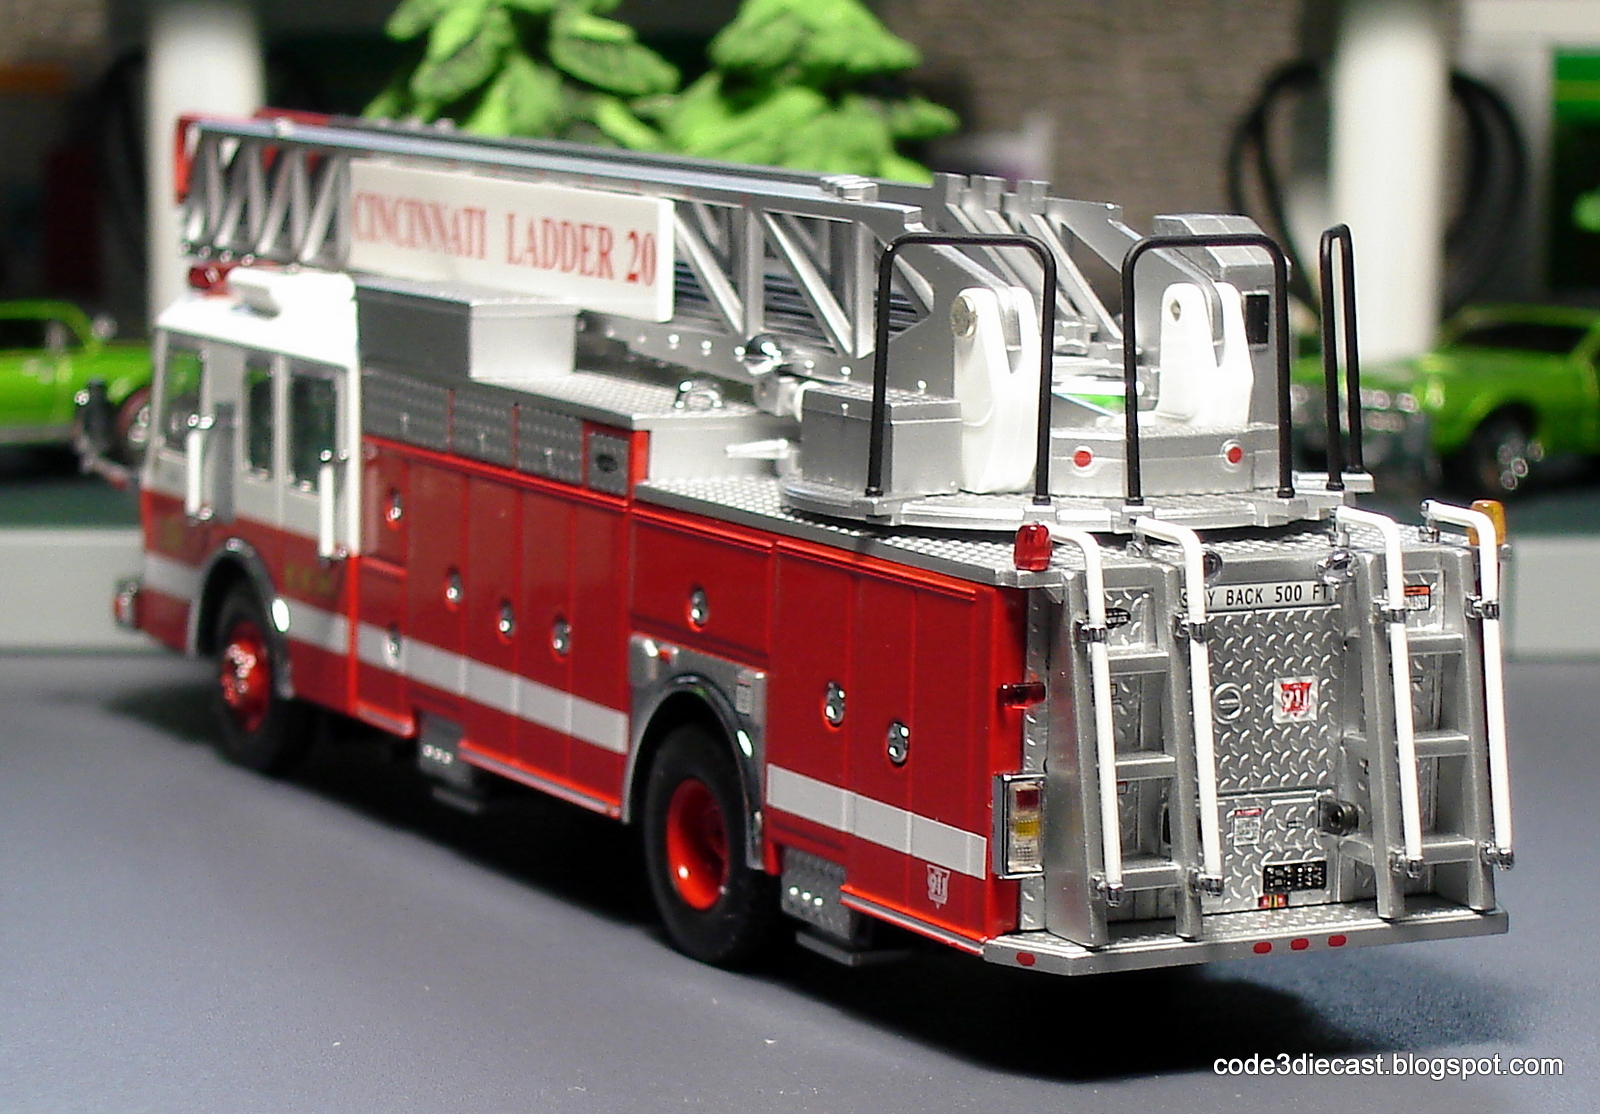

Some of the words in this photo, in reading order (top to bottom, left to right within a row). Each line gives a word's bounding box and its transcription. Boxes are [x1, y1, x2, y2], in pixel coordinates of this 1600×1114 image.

[352, 190, 486, 260] CINCINNATI
[506, 213, 614, 280] LADDER
[626, 230, 657, 287] 20
[1181, 590, 1216, 609] SY
[1226, 588, 1264, 606] BACK
[1275, 584, 1303, 603] 500
